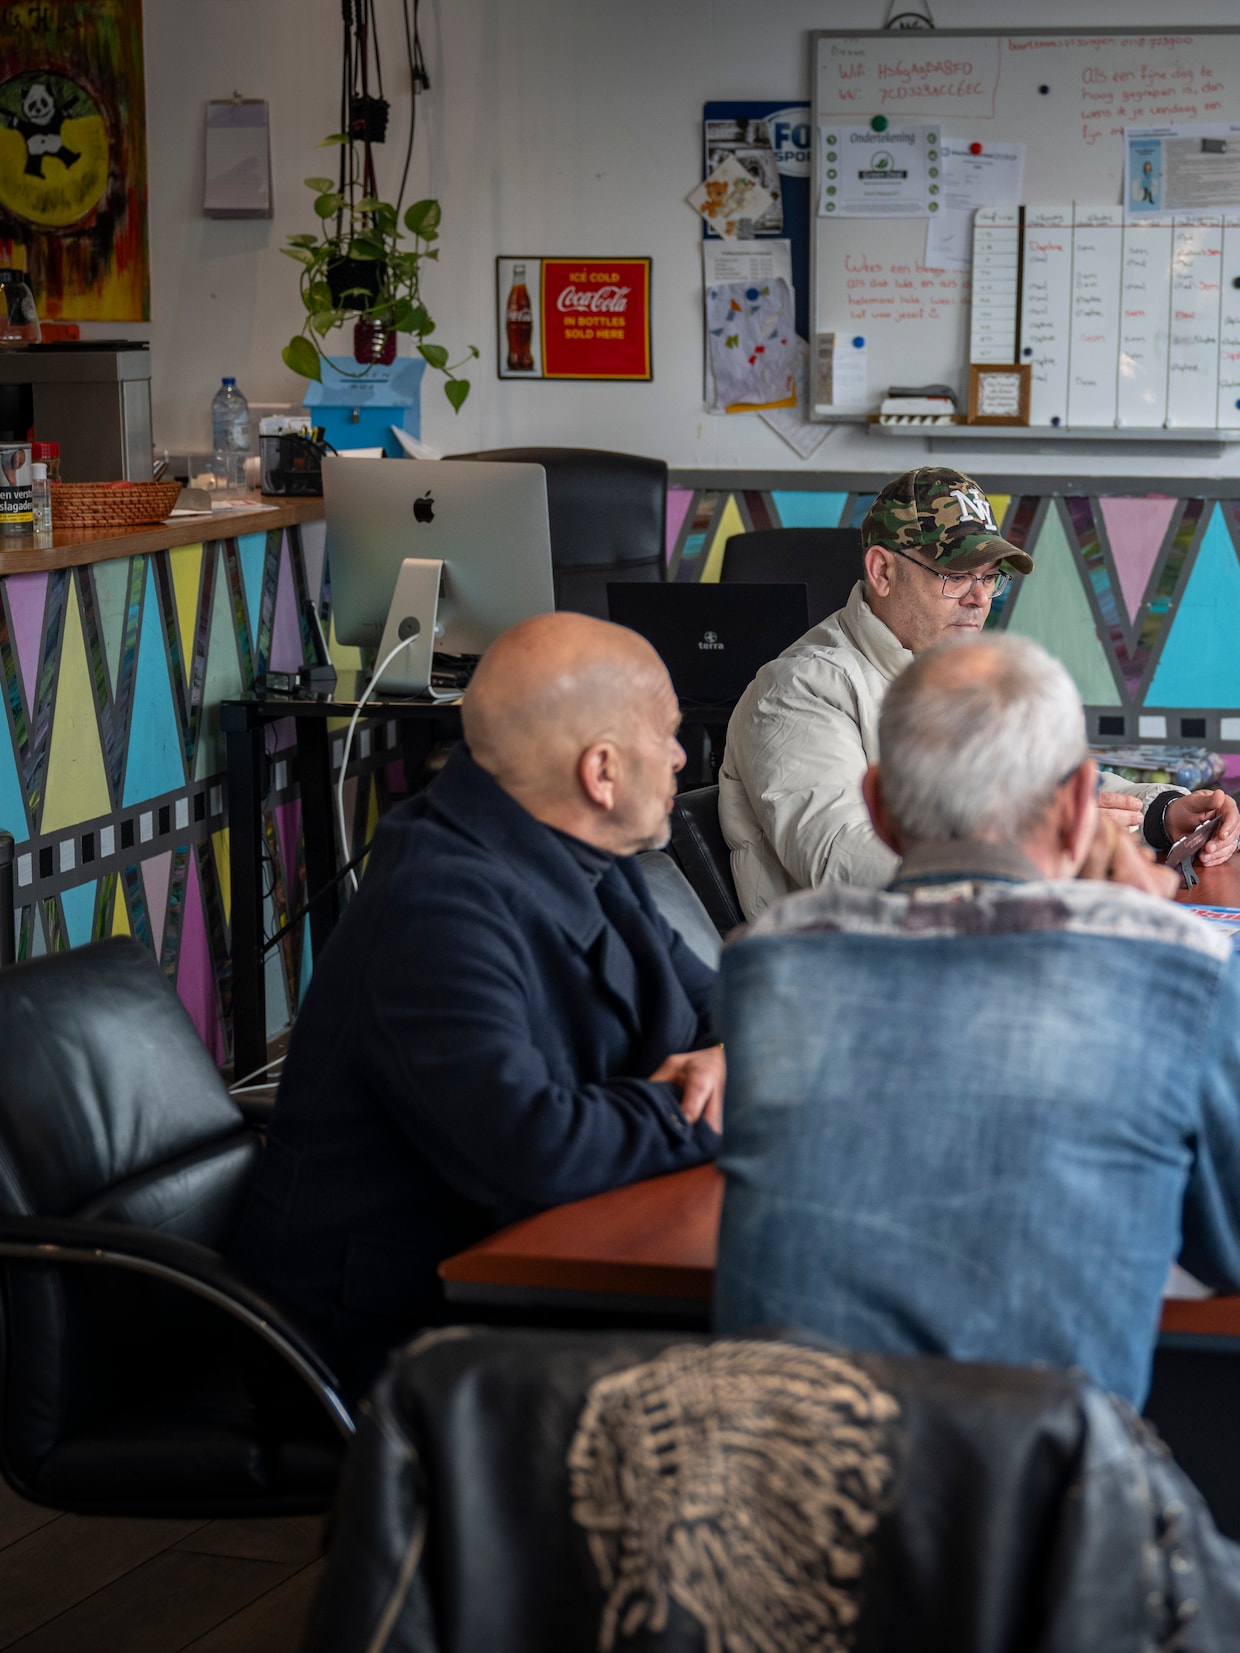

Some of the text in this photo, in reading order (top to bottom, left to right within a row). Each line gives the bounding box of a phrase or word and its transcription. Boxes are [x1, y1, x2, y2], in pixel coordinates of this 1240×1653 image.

[1112, 70, 1135, 82] een
[1171, 67, 1194, 83] dag
[1200, 64, 1213, 77] te
[1082, 87, 1114, 104] hoog
[1201, 80, 1224, 93] dan
[1081, 108, 1112, 120] wens
[1129, 107, 1144, 121] je
[1150, 104, 1197, 119] vandaag
[1204, 101, 1222, 111] een
[849, 131, 916, 146] Ondertekening
[891, 264, 911, 273] een
[569, 272, 620, 283] ICE COLD
[563, 316, 626, 327] IN BOTTLES
[564, 329, 625, 339] SOLD HERE
[698, 641, 725, 651] terra
